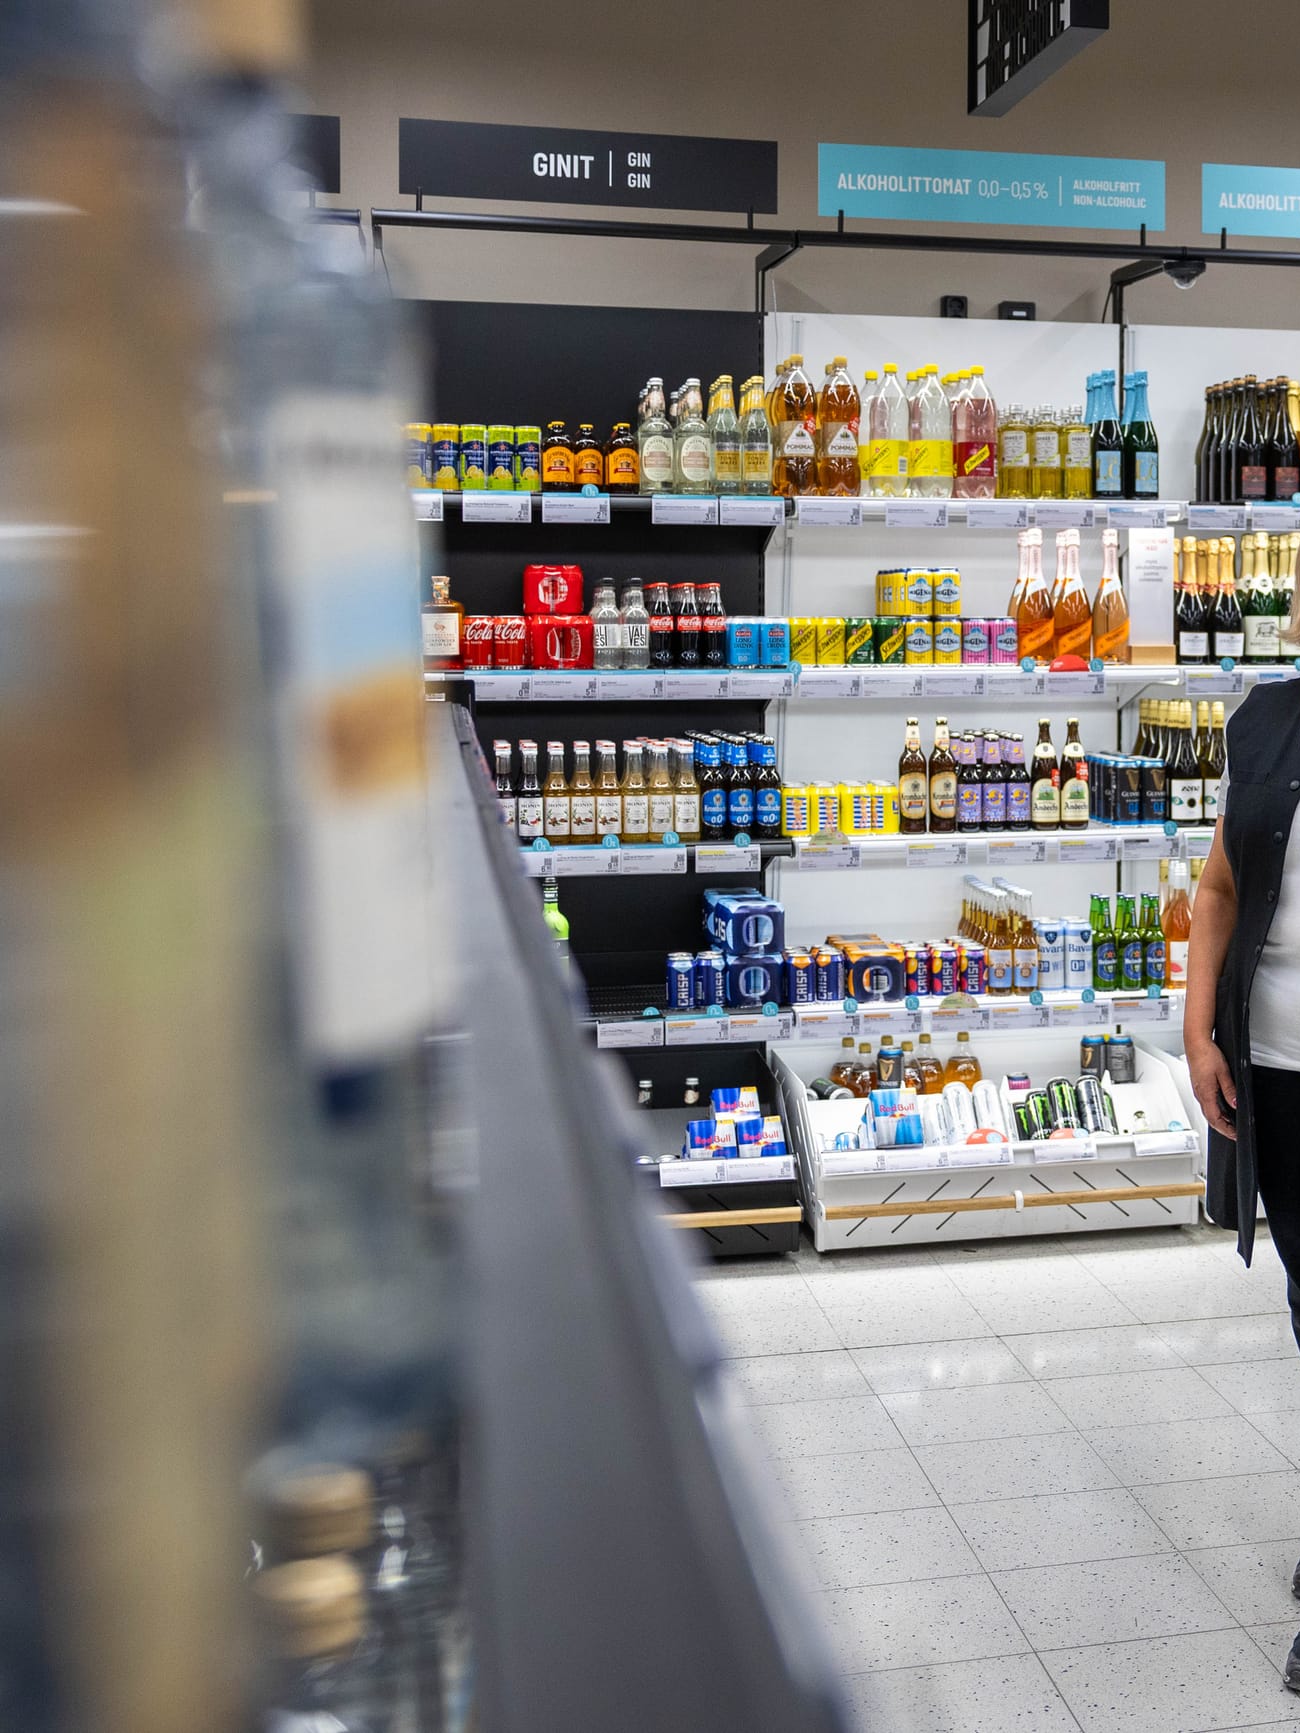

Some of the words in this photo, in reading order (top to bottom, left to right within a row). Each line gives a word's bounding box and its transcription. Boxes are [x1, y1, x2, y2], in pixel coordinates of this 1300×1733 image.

[533, 151, 594, 181] GINIT
[627, 151, 651, 168] GIN
[627, 172, 651, 190] GIN
[837, 172, 972, 197] ALKOHOLITTOMAT
[1073, 178, 1141, 194] ALKOHOLFRITT
[1073, 194, 1147, 209] NON-ALCOHOLIC
[917, 961, 929, 994] CRISP
[967, 960, 979, 993] CRISP
[678, 974, 689, 1007] CRISP
[797, 970, 808, 1002] CRISP
[738, 1100, 755, 1109] Bull
[898, 1103, 915, 1113] Bull
[713, 1134, 732, 1143] Bull
[762, 1130, 780, 1141] Bull
